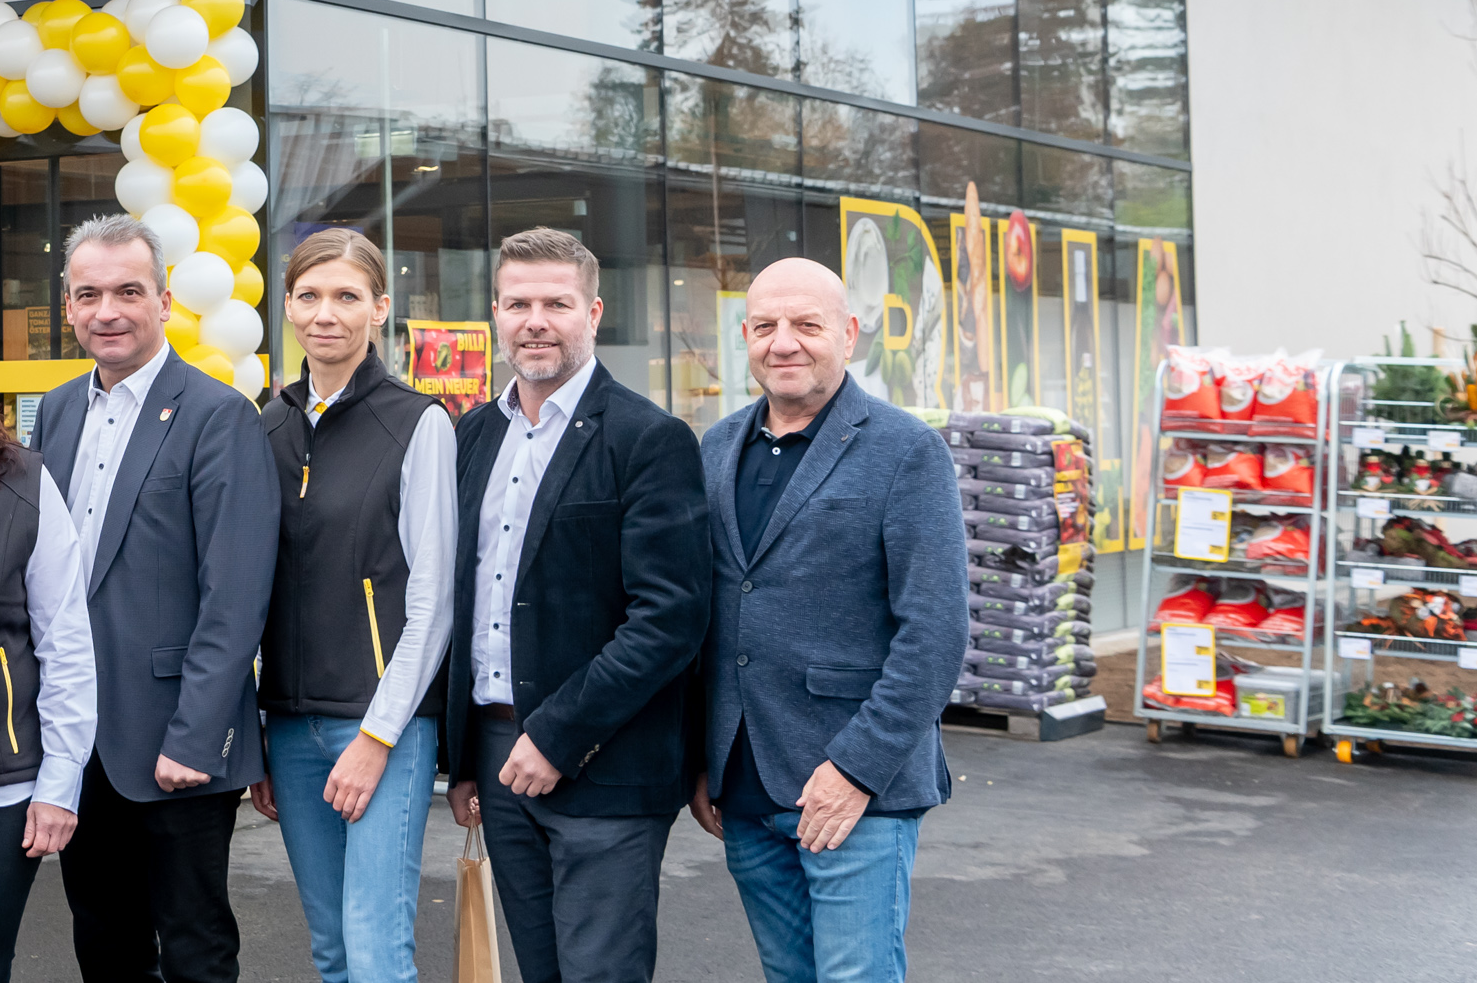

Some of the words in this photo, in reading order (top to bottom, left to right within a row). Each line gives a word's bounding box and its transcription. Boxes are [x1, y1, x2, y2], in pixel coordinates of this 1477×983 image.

[456, 333, 485, 352] BILLA
[414, 378, 444, 395] MEIN
[445, 378, 480, 395] NEUER
